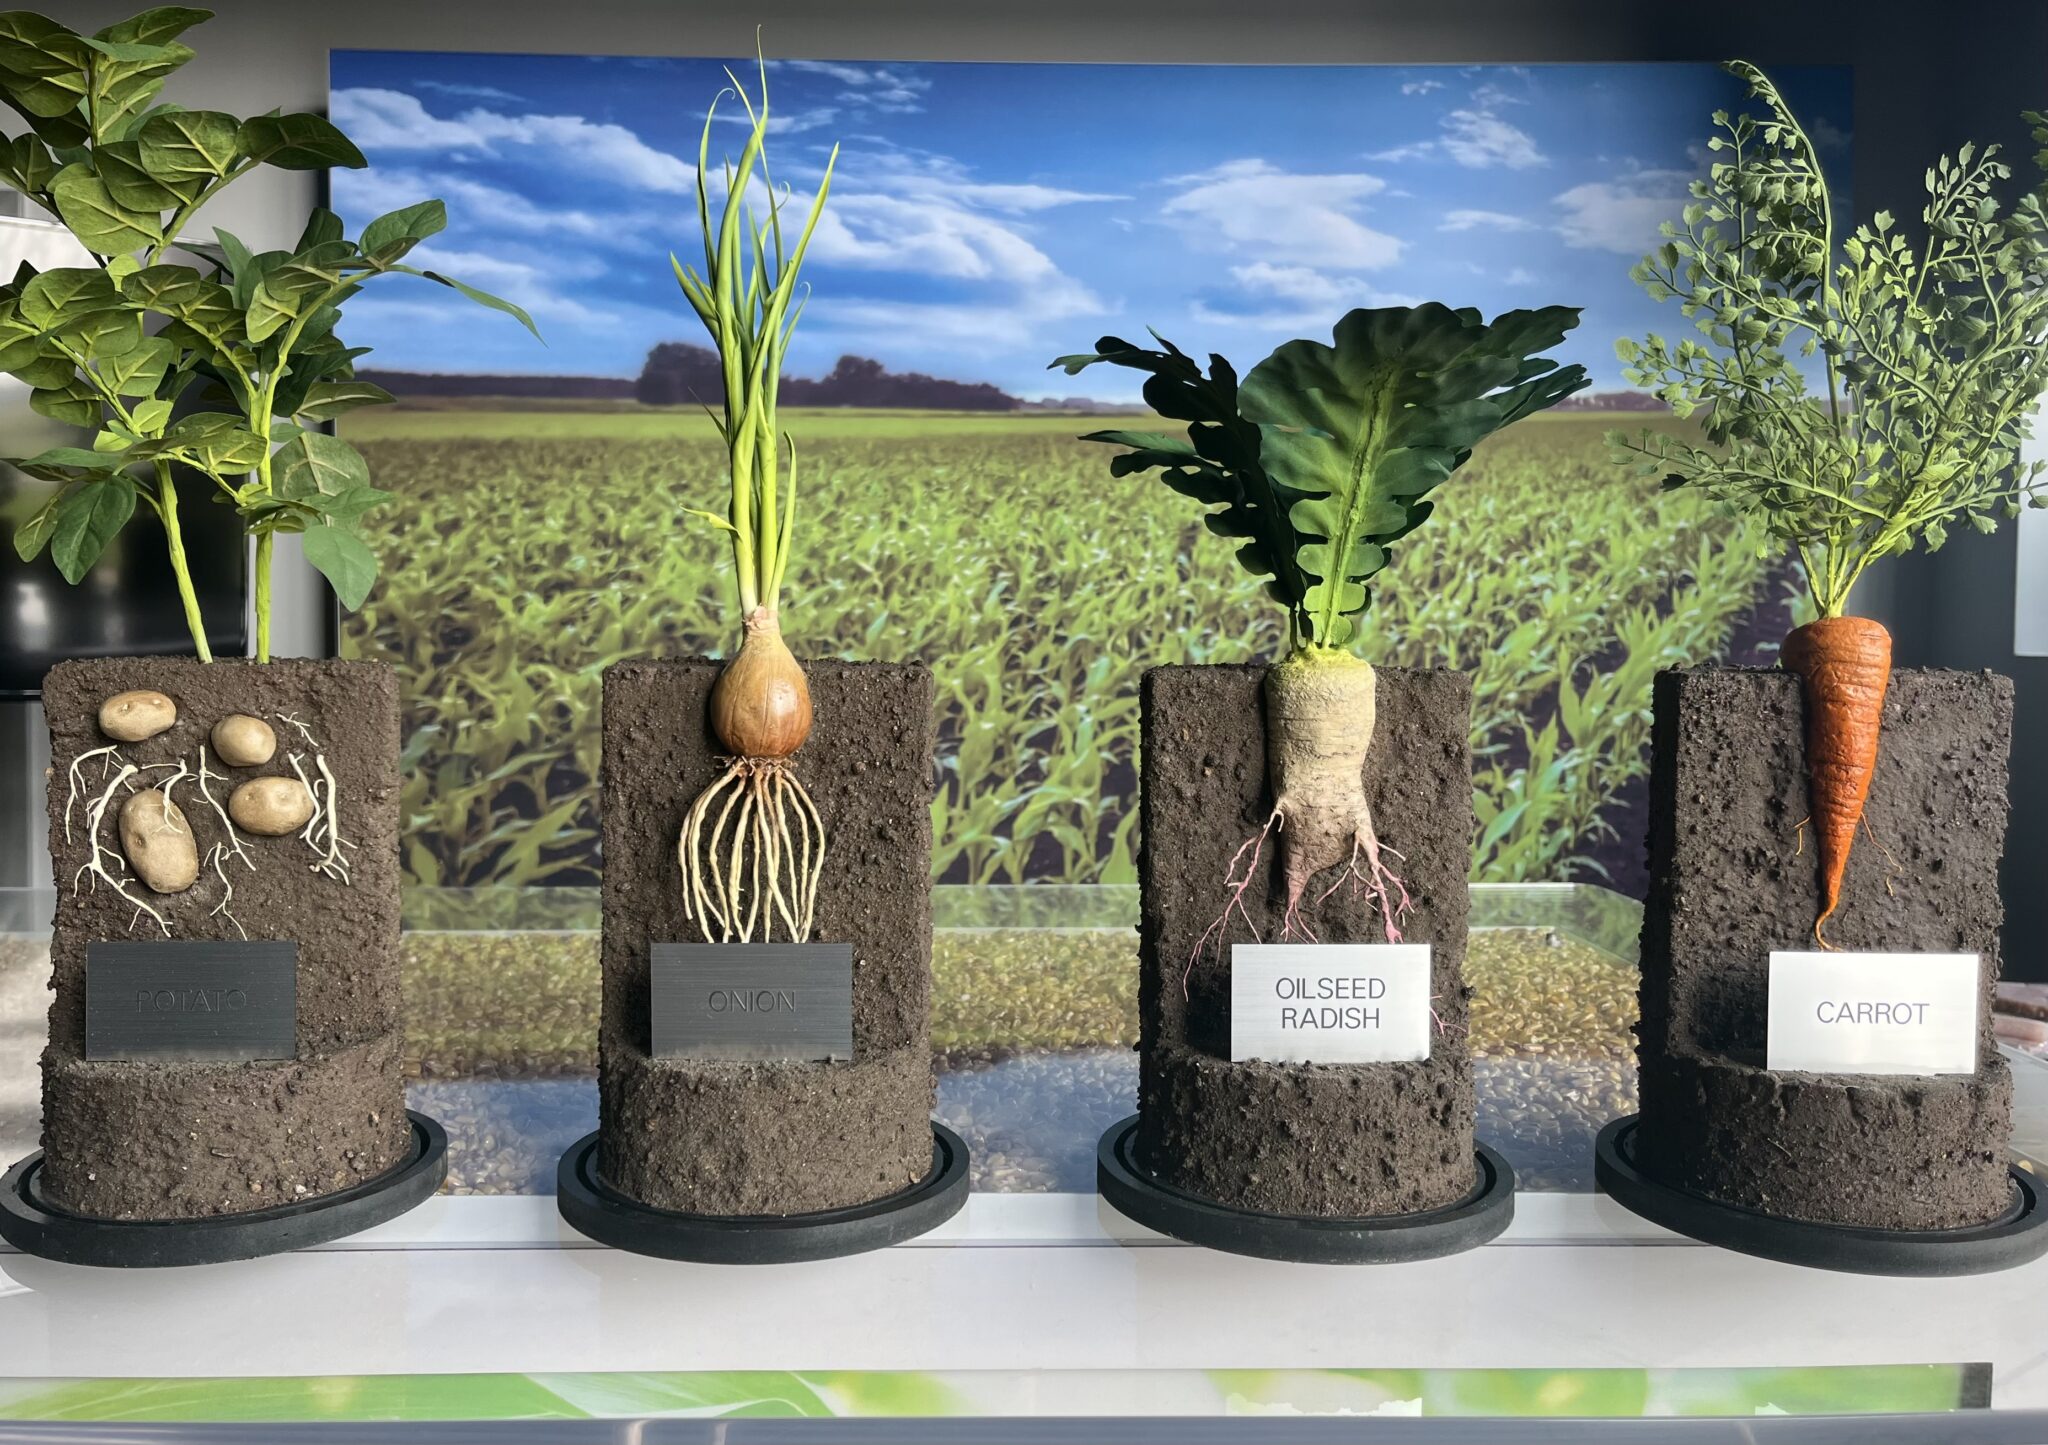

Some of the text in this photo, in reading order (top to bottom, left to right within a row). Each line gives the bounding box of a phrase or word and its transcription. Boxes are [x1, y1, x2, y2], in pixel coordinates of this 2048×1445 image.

[1275, 977, 1386, 1000] OILSEED
[136, 989, 247, 1013] POTATO
[708, 990, 796, 1012] ONION
[1281, 1007, 1380, 1029] RADISH
[1816, 1001, 1930, 1025] CARROT
